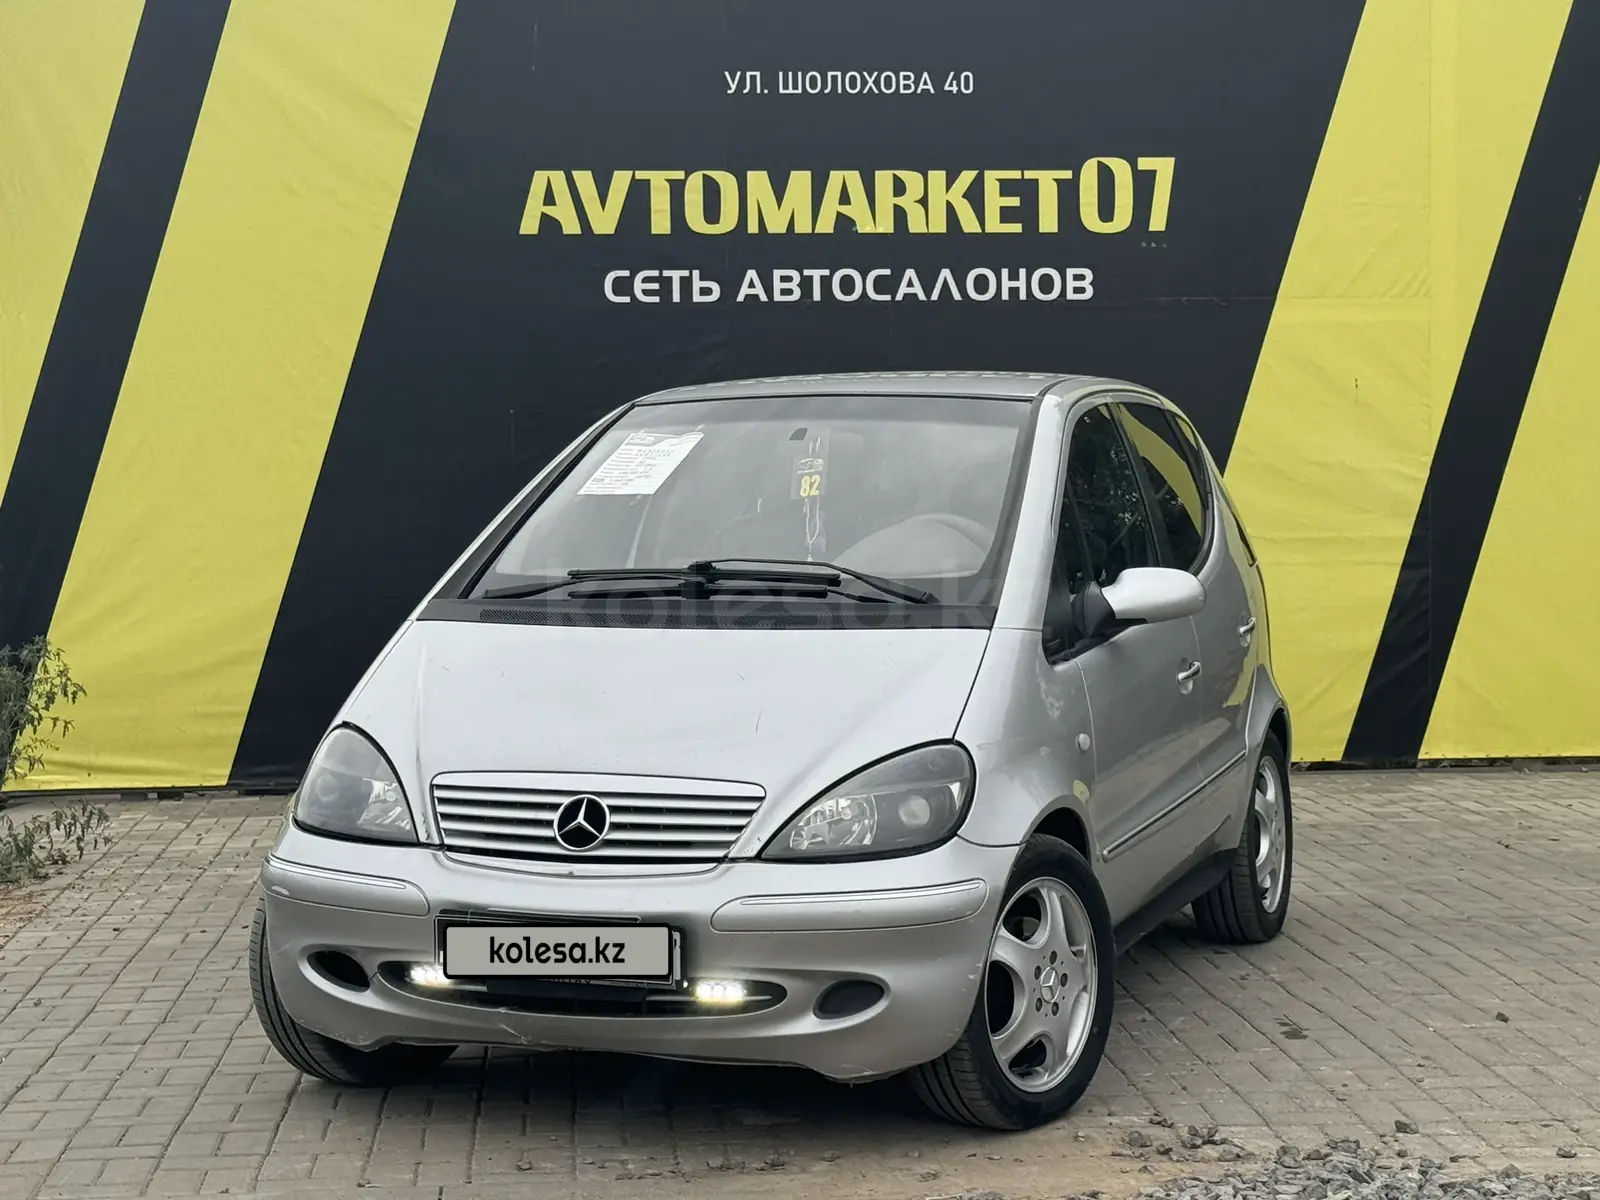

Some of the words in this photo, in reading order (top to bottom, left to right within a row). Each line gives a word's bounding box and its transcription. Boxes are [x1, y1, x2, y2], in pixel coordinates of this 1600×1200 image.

[723, 71, 769, 94] УЛ.
[778, 71, 935, 95] ШОЛОХОВА
[943, 71, 974, 94] 40
[519, 157, 1176, 235] AVTOMARKET07
[604, 269, 721, 303] СЕТЬ
[736, 268, 1094, 302] АВТОСАЛОНОВ
[800, 475, 821, 497] 82
